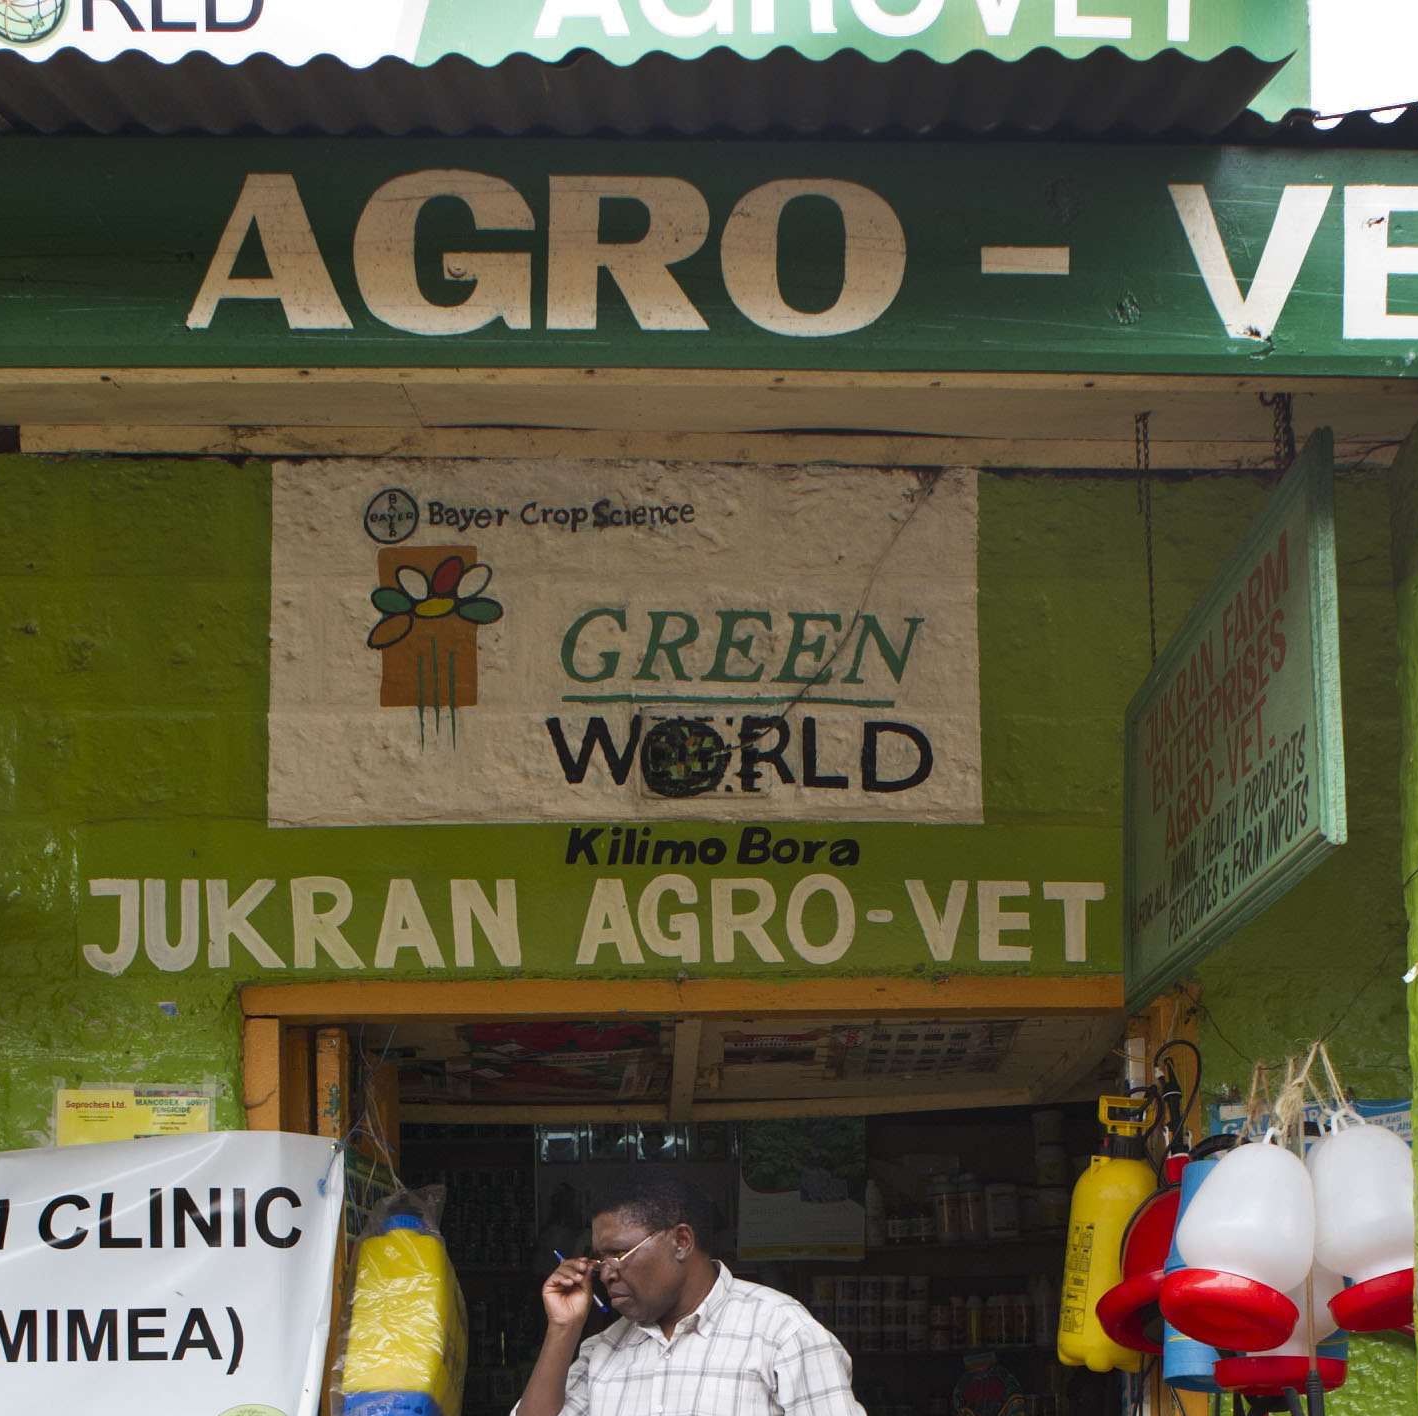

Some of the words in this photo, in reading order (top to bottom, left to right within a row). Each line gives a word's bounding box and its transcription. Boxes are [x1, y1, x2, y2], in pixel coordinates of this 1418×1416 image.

[186, 168, 907, 337] AGRO
[427, 500, 509, 532] Bayer
[560, 606, 925, 685] GREEN
[1146, 631, 1213, 765] JUKRAN
[1223, 528, 1289, 667] FARM
[546, 714, 934, 797] WORLD
[1152, 608, 1287, 816] ENTERPRISES
[565, 827, 728, 866] Kilimo
[736, 826, 861, 867] Bora
[1169, 836, 1198, 898] ANIMAL
[1202, 793, 1239, 868] HEALTH
[1243, 723, 1306, 830] PRODUCTS
[1168, 862, 1218, 948] PESTICIDES
[1232, 823, 1263, 890] FARM
[1267, 774, 1309, 861] INPUTS
[82, 877, 521, 976] JUKRAN
[37, 1186, 303, 1251] CLINIC
